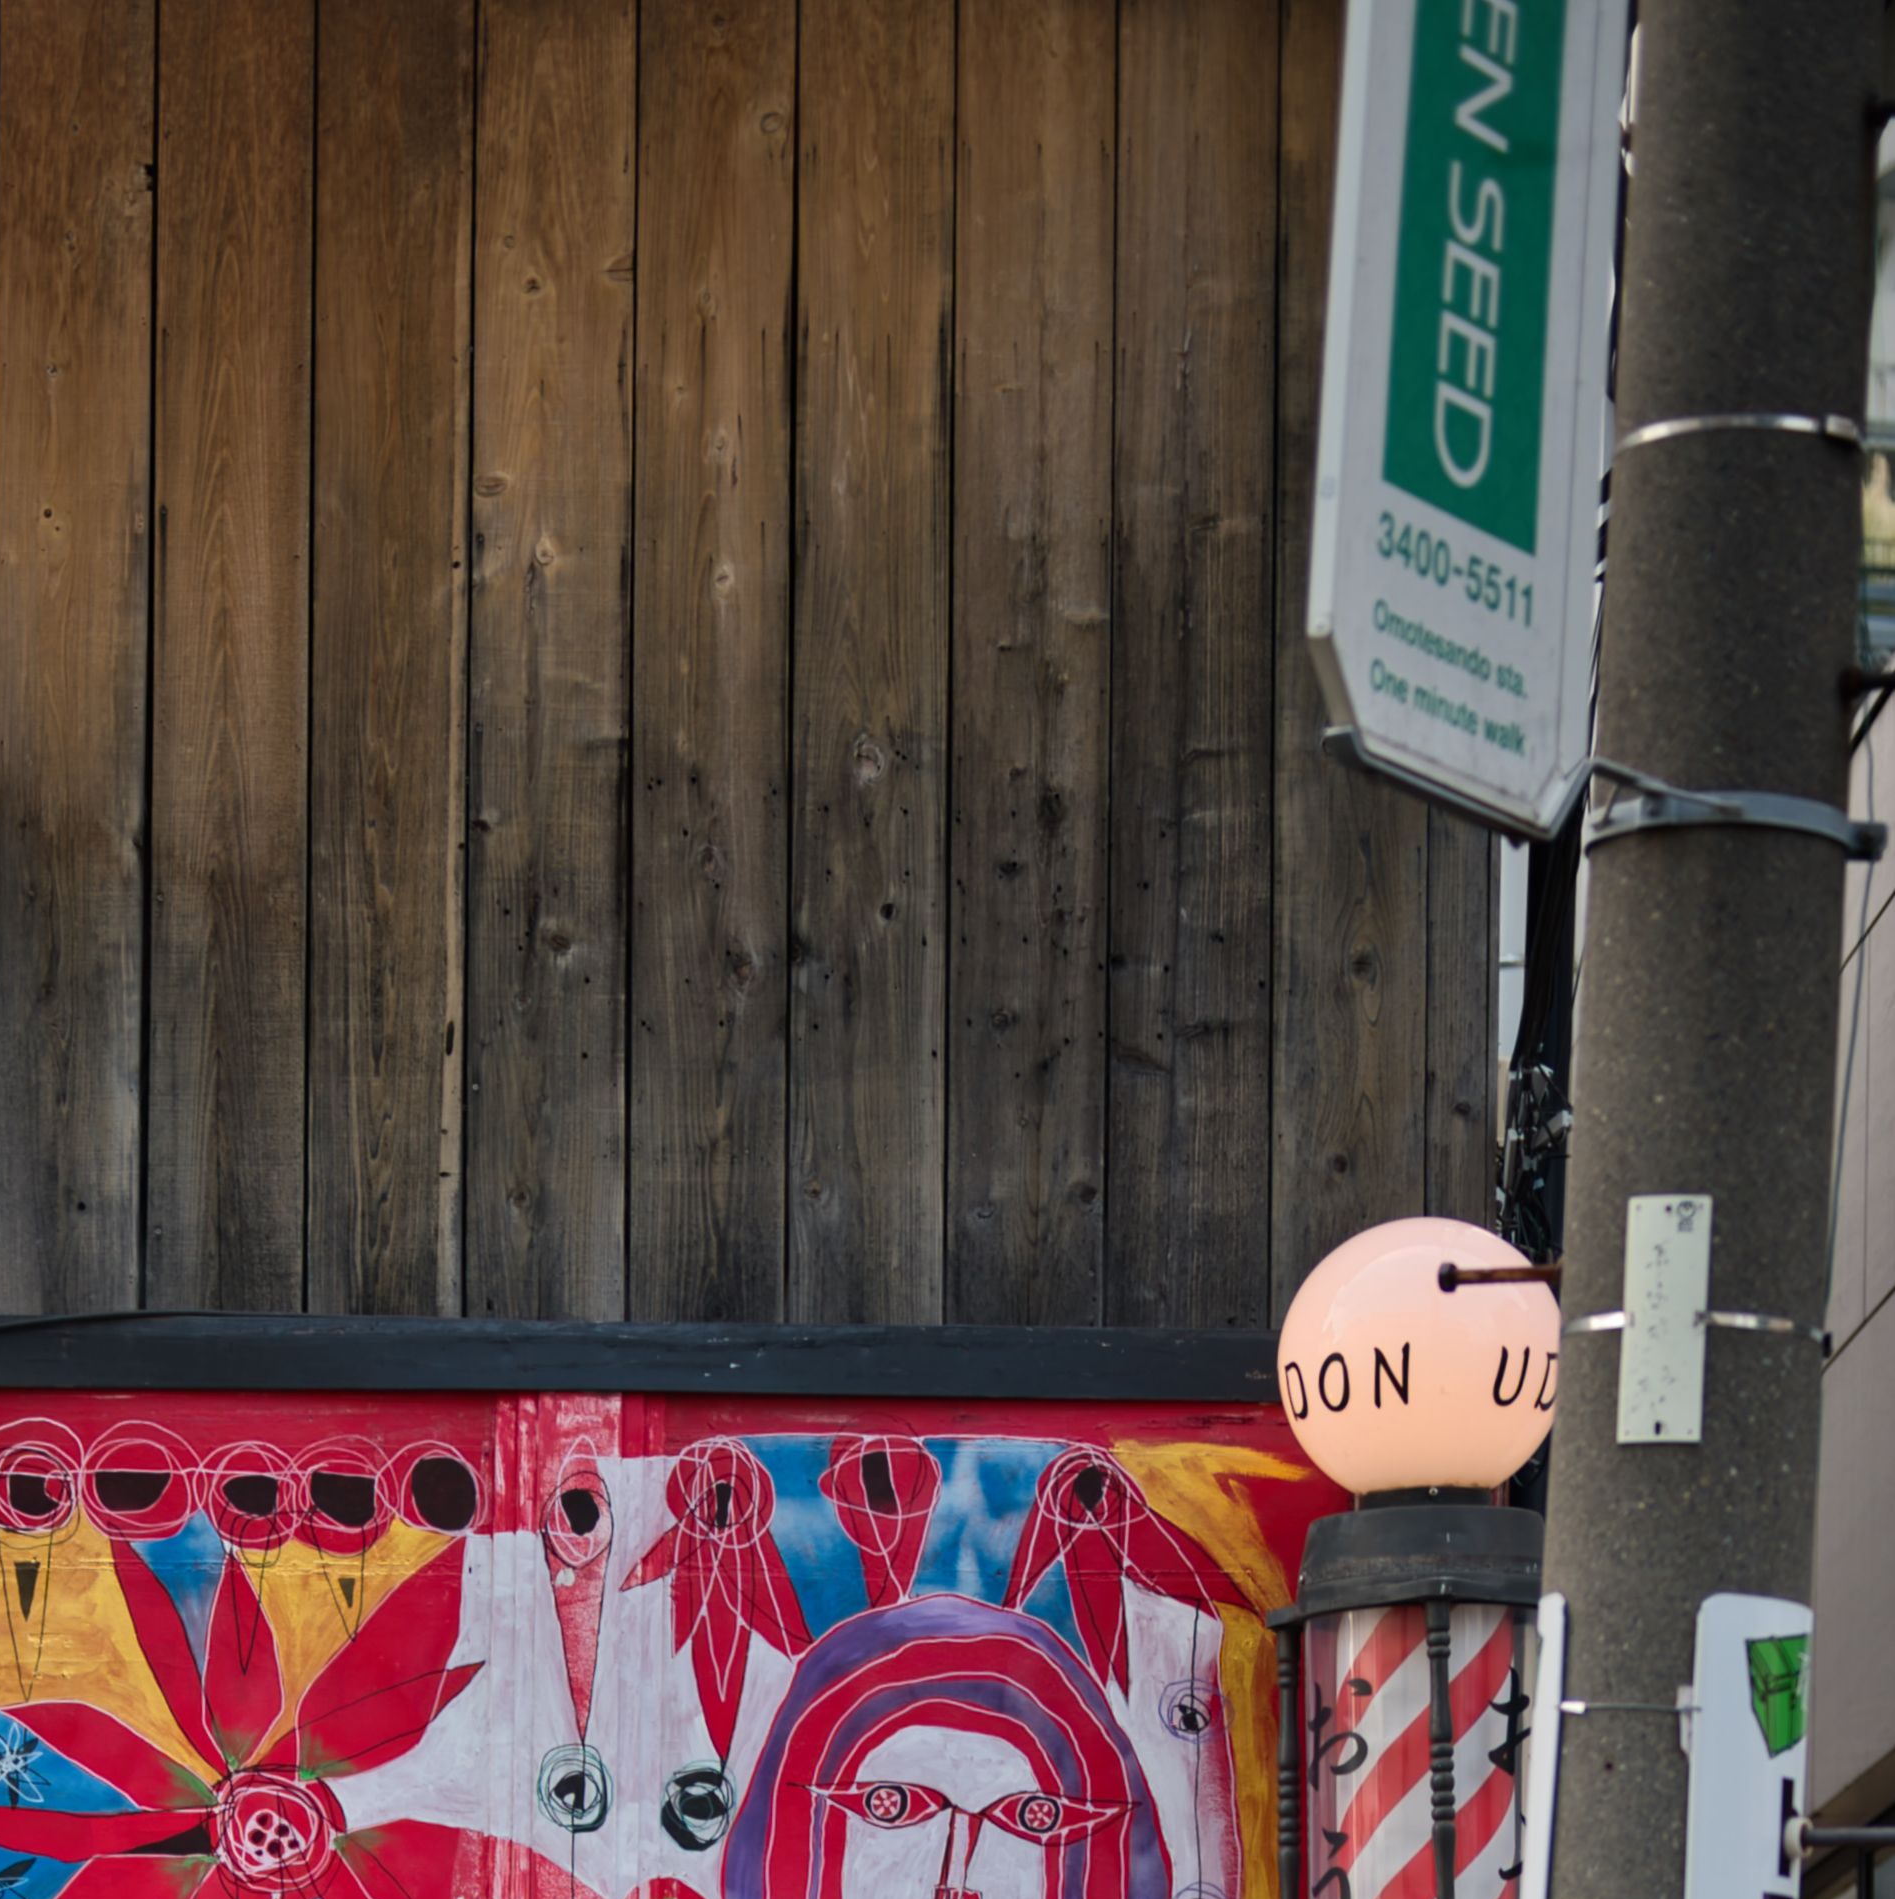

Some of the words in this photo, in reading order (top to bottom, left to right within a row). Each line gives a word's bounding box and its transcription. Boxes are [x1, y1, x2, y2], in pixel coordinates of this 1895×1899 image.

[1433, 158, 1505, 489] SEED
[1377, 509, 1534, 629] 3400-5511
[1372, 597, 1492, 682] Omotesando
[1496, 661, 1529, 699] sta.
[1368, 656, 1408, 705] One
[1414, 685, 1479, 736] minute
[1484, 716, 1527, 758] walk
[1284, 1342, 1411, 1421] DON
